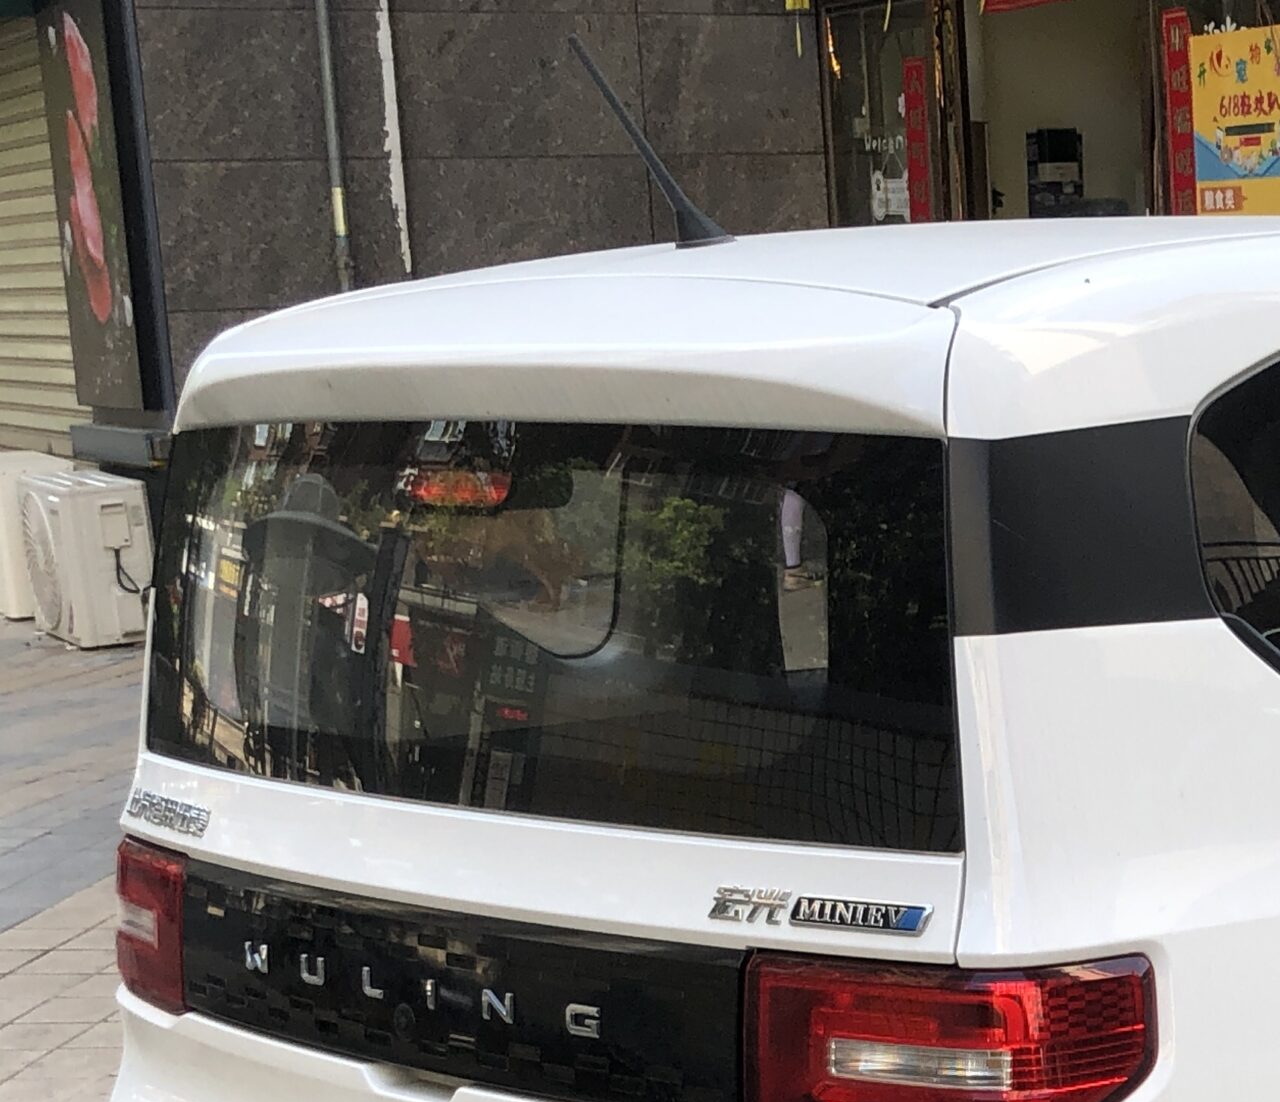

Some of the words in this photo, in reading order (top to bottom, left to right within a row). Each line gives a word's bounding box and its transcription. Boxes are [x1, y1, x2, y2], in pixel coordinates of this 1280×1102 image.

[707, 884, 793, 927] 宏光
[795, 898, 908, 930] MINIEV
[244, 940, 601, 1039] WULING
